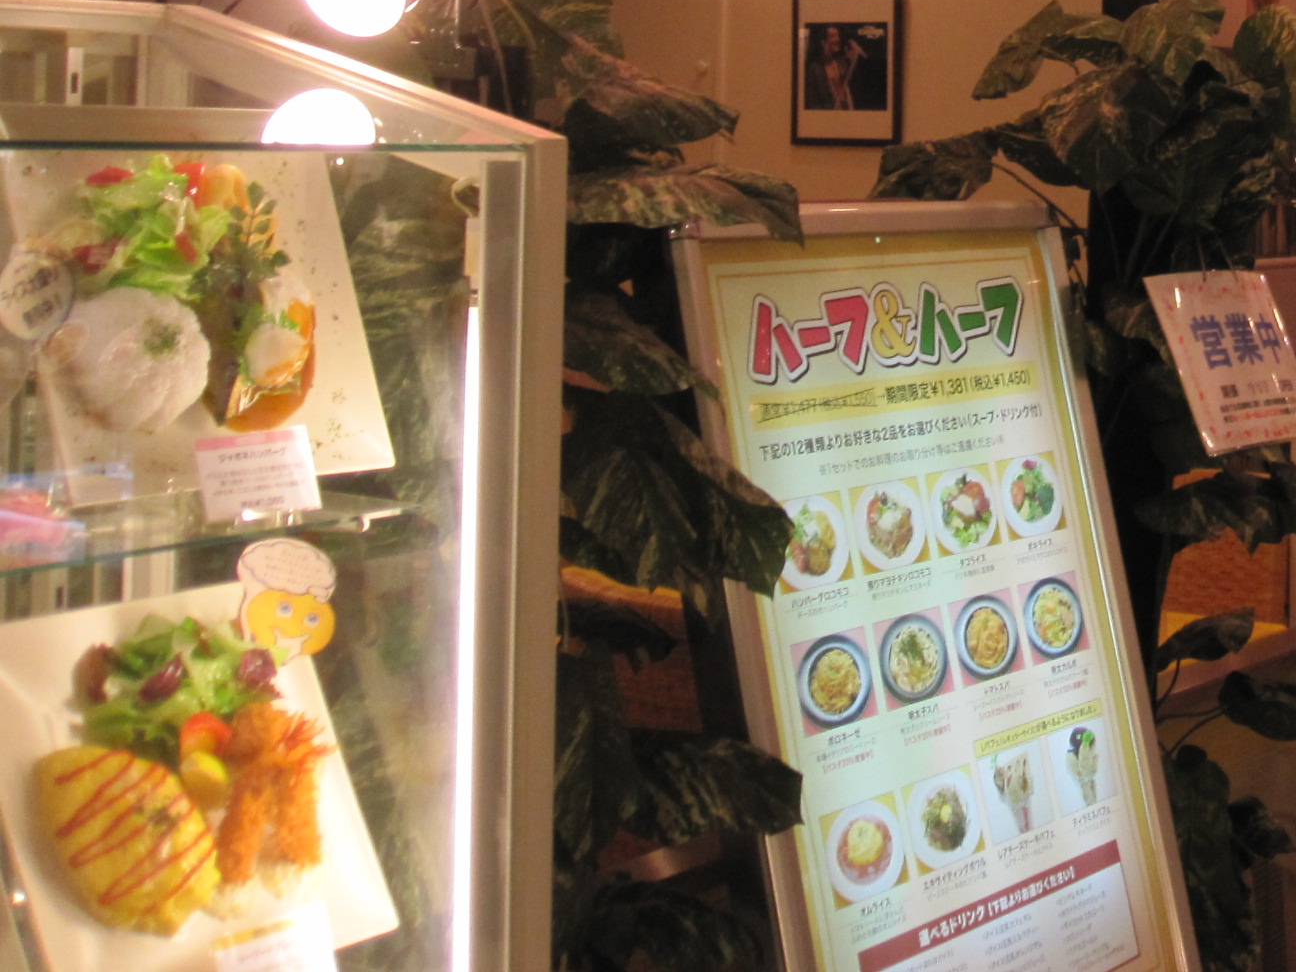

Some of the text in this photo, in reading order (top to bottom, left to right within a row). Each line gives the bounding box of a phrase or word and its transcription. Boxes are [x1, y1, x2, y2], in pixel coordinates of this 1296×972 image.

[748, 277, 1024, 383] ハーフ&ハーフ
[1189, 313, 1281, 369] 営業中
